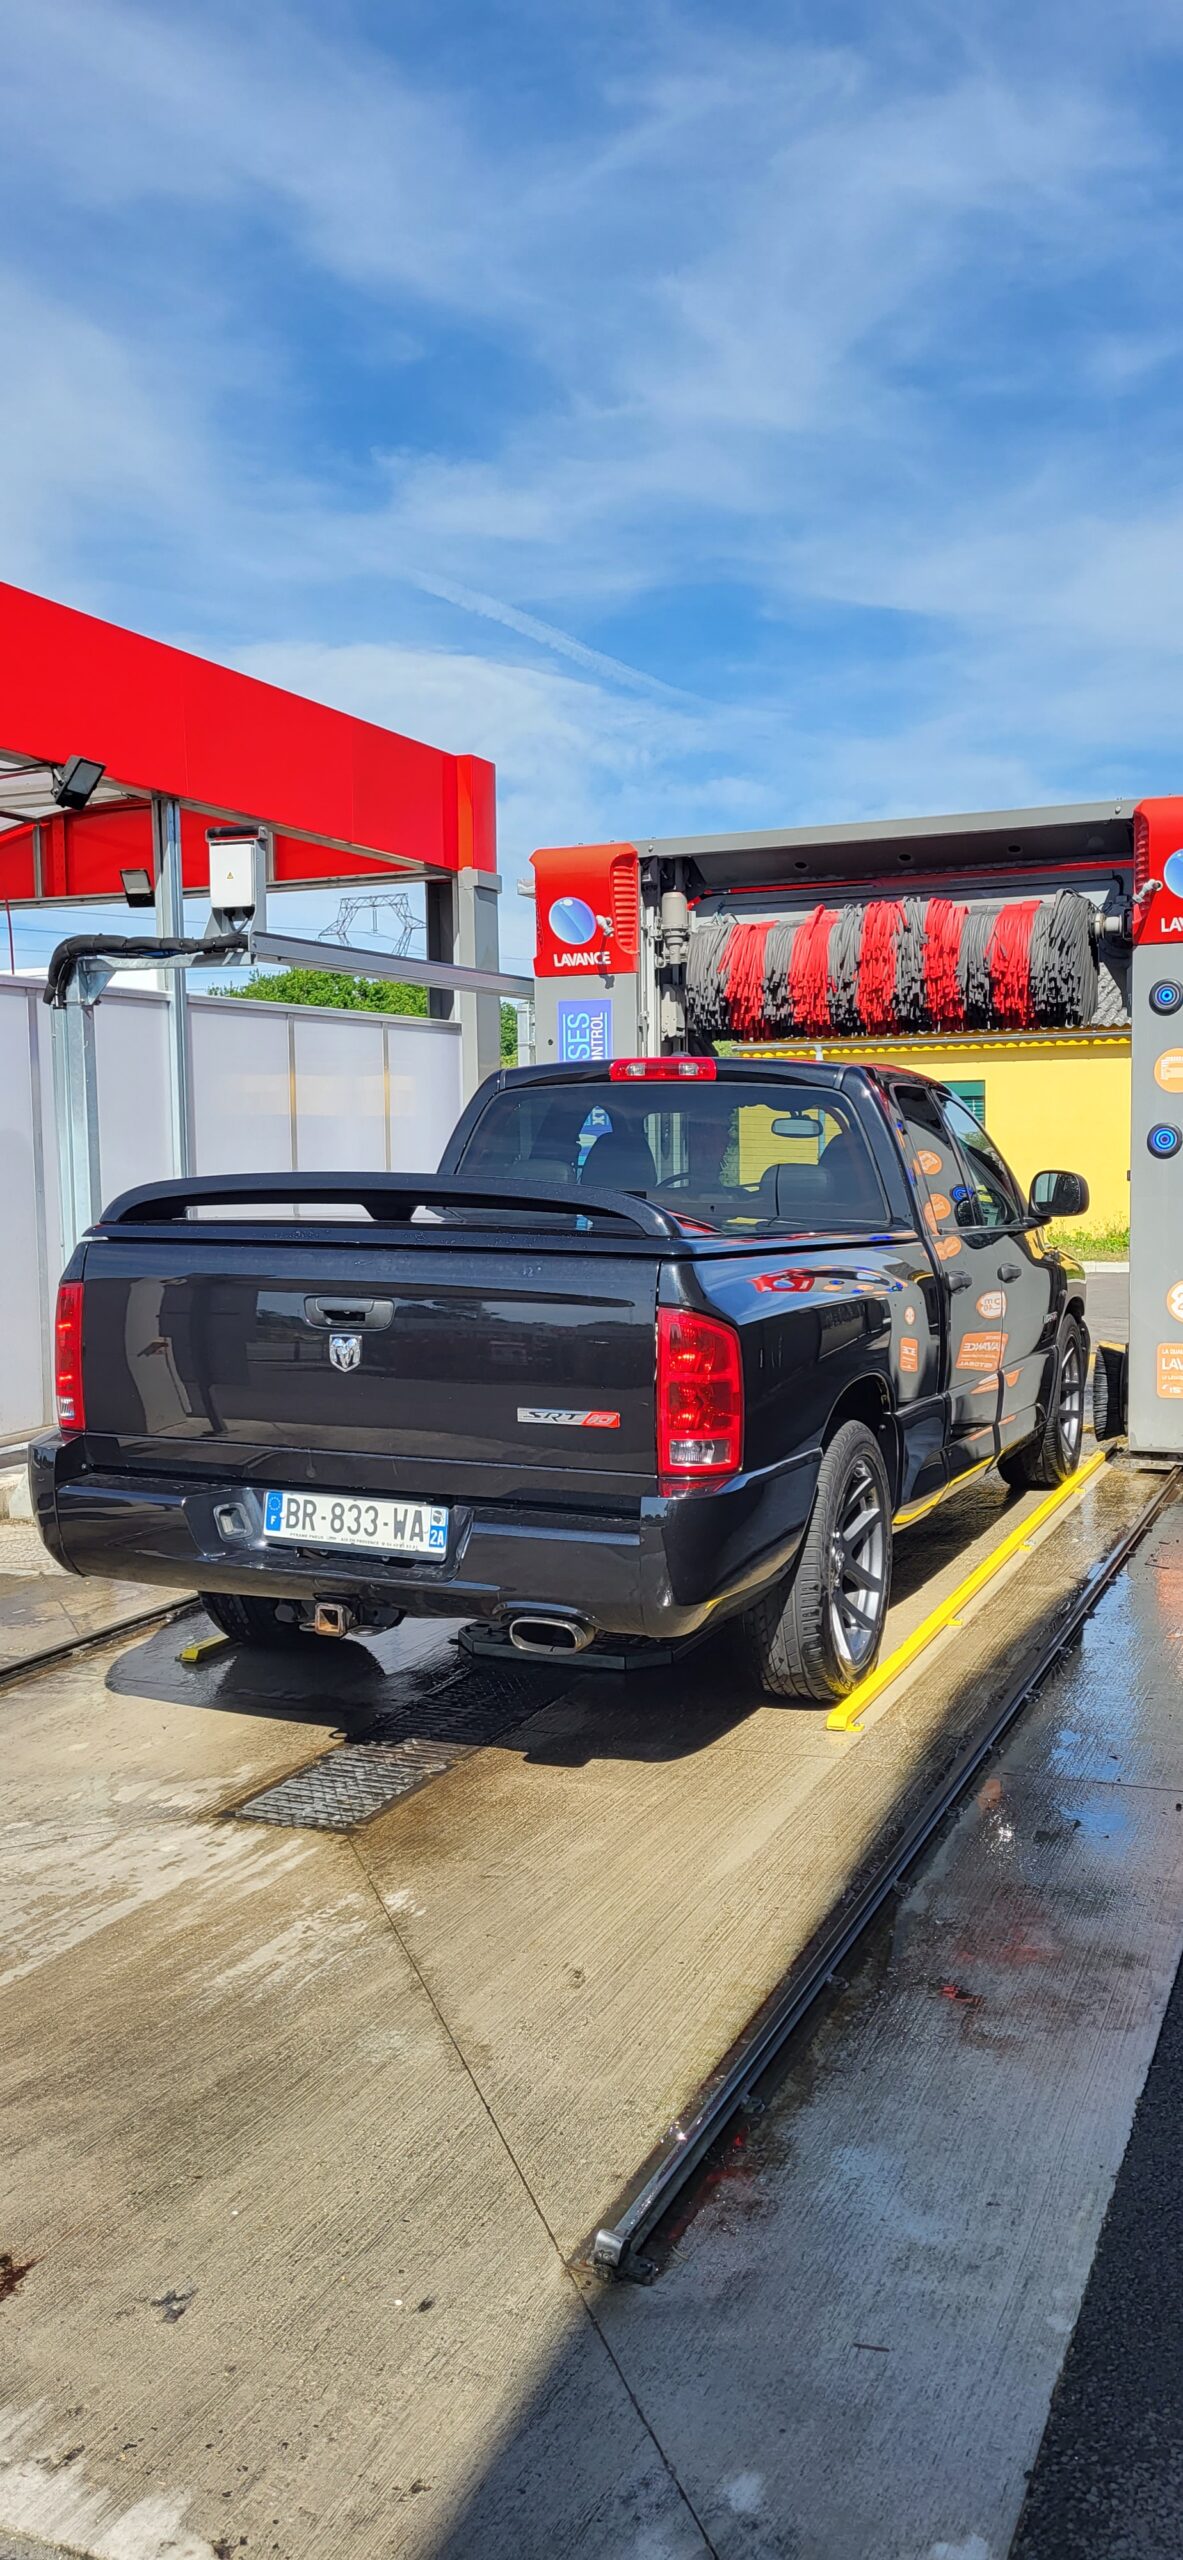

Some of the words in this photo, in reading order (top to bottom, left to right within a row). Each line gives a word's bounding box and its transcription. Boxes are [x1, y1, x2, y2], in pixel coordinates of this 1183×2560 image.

[553, 951, 611, 967] LAVANCE
[567, 1012, 590, 1060] SES
[523, 1411, 583, 1422] SRT
[270, 1515, 277, 1525] F
[286, 1498, 424, 1543] BR-833-WA
[429, 1529, 444, 1546] 2A
